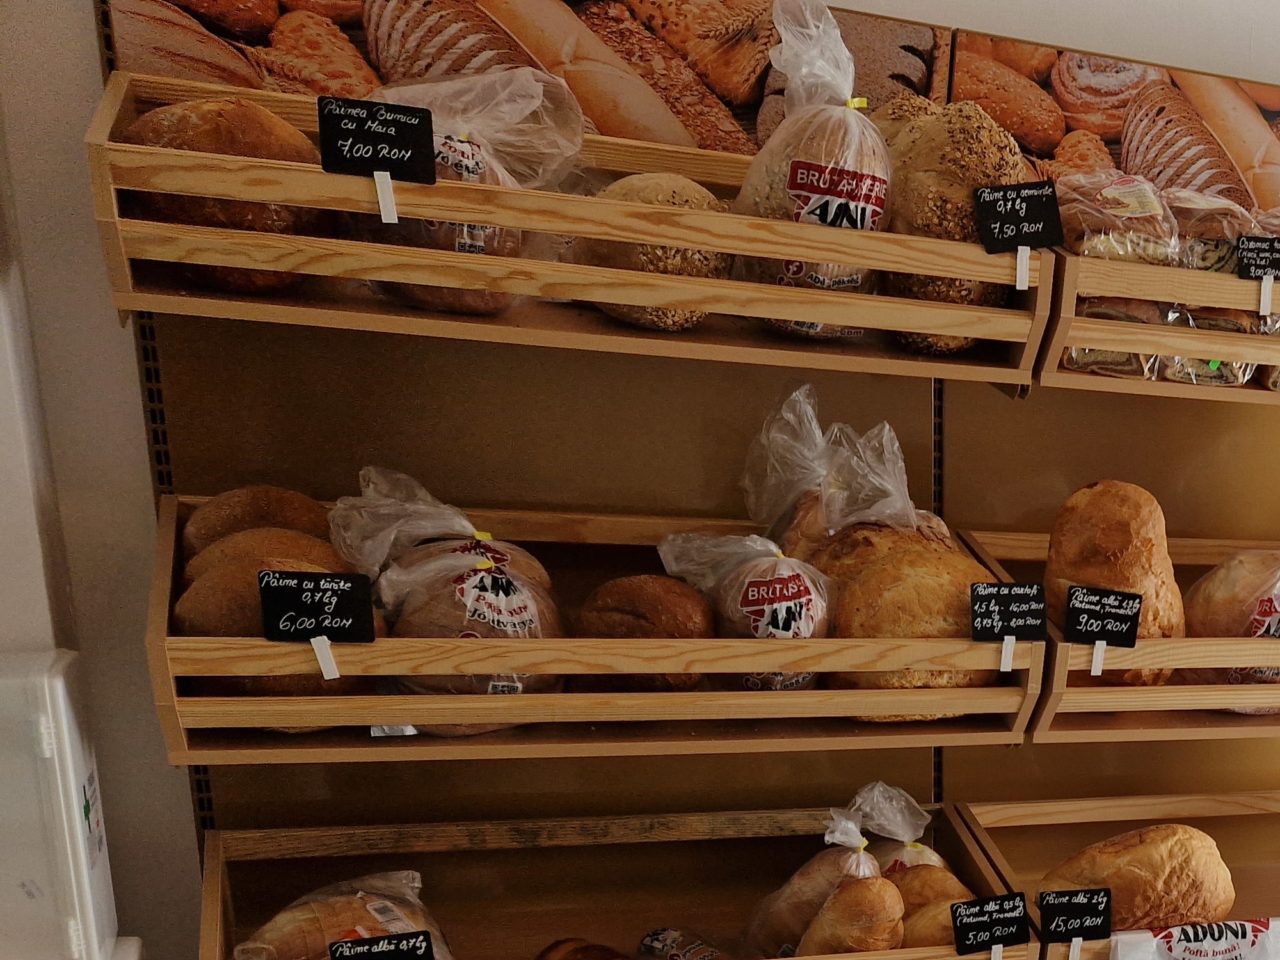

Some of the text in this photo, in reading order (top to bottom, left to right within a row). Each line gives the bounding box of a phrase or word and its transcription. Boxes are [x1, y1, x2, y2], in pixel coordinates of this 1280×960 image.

[341, 119, 356, 130] cu
[337, 138, 373, 159] 7,00
[378, 144, 412, 161] RON
[978, 188, 1004, 203] Pâine
[1007, 190, 1017, 199] cu
[997, 198, 1027, 217] 0,7 kg
[991, 221, 1044, 239] 7,50 RON
[259, 570, 298, 588] Pâine
[302, 580, 313, 588] cu
[973, 584, 998, 595] Pâine
[1000, 587, 1009, 595] cu
[1071, 588, 1100, 603] Pâine
[302, 590, 338, 612] 0,7 kg
[974, 601, 988, 614] 1,5
[1029, 601, 1045, 610] RON
[279, 612, 353, 632] 6,00 RON
[974, 617, 992, 630] 0,75
[1025, 616, 1042, 626] RON
[1076, 614, 1131, 633] 9,00 RON
[1042, 892, 1070, 905] Pâine
[1071, 891, 1089, 904] albă
[953, 903, 980, 917] Pâine
[984, 900, 1000, 912] albă
[1050, 916, 1104, 933] 15,00 RON
[1177, 921, 1248, 944] ADONI
[965, 925, 1017, 945] 5,00 RON
[332, 942, 370, 957] Pâine
[371, 939, 397, 952] albă
[400, 938, 416, 951] 0,7
